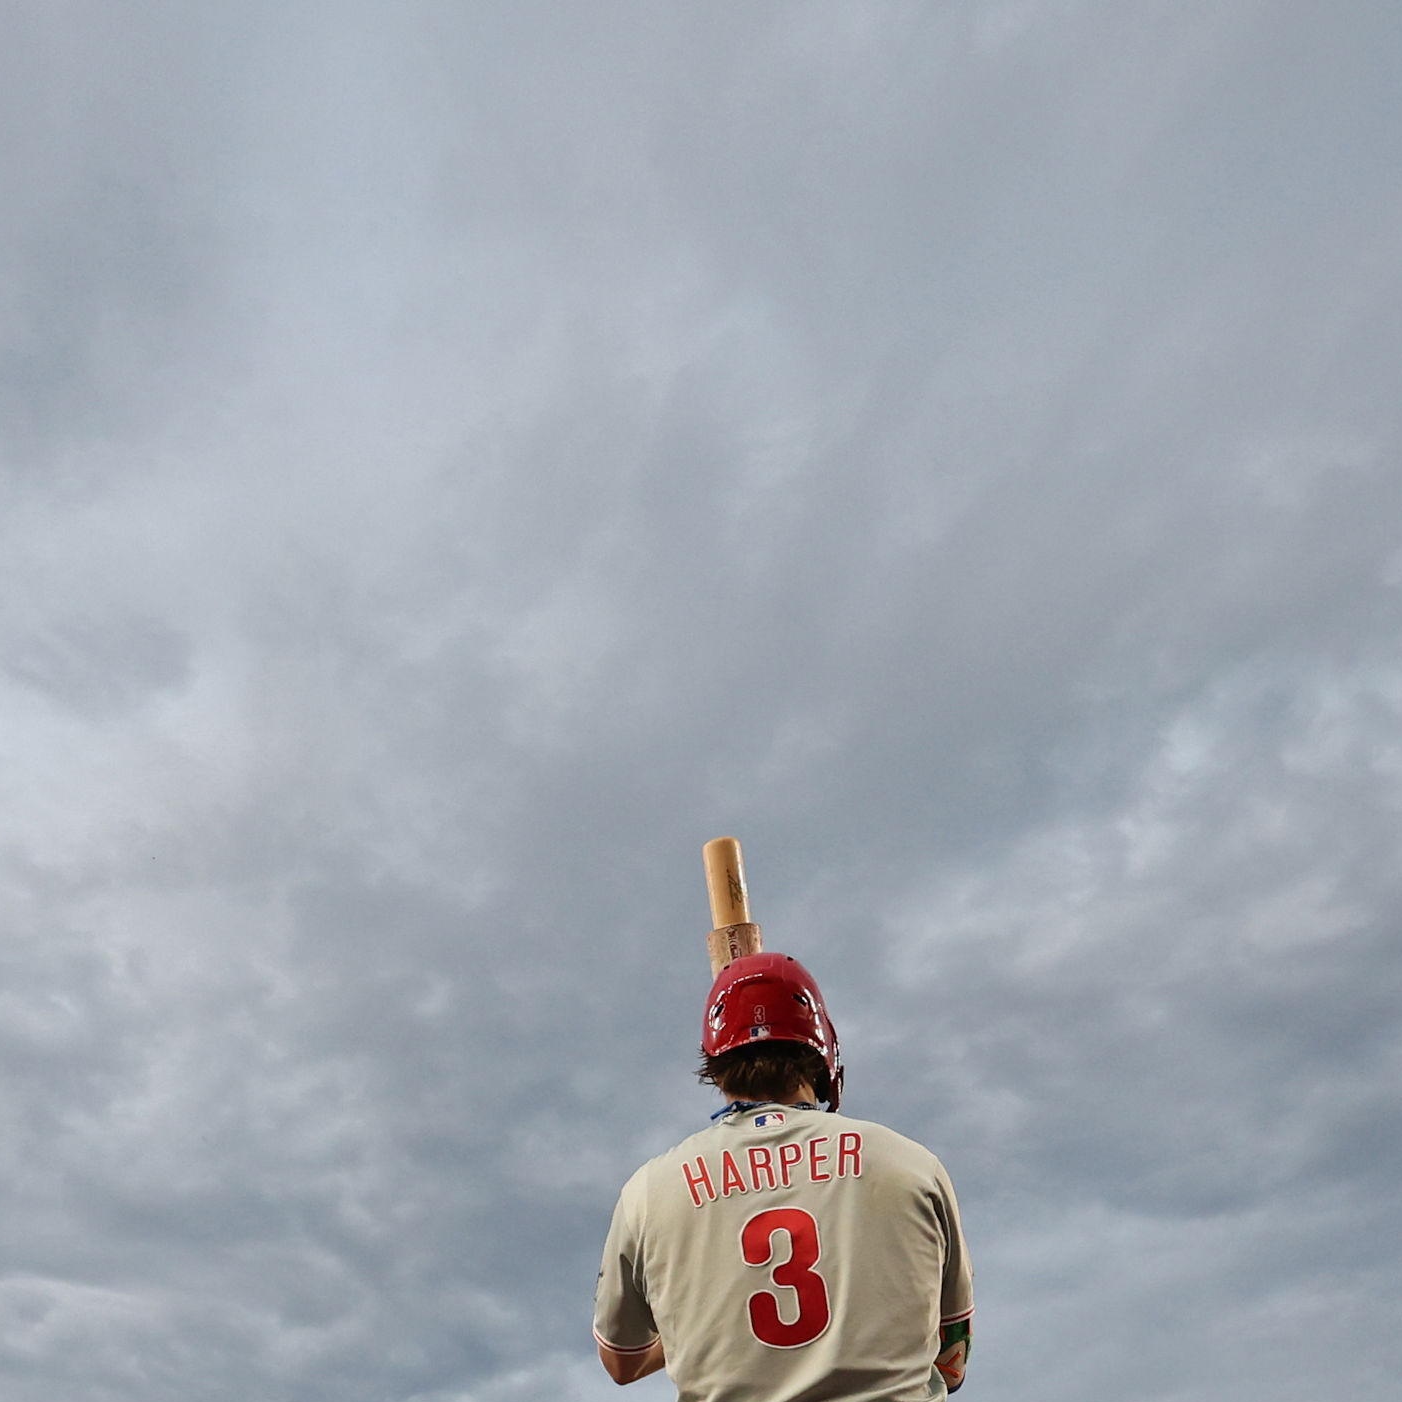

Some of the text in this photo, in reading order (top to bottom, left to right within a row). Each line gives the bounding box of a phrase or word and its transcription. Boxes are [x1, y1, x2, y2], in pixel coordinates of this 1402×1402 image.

[754, 1005, 766, 1025] 3
[681, 1131, 863, 1208] HARPER
[739, 1206, 831, 1350] 3
